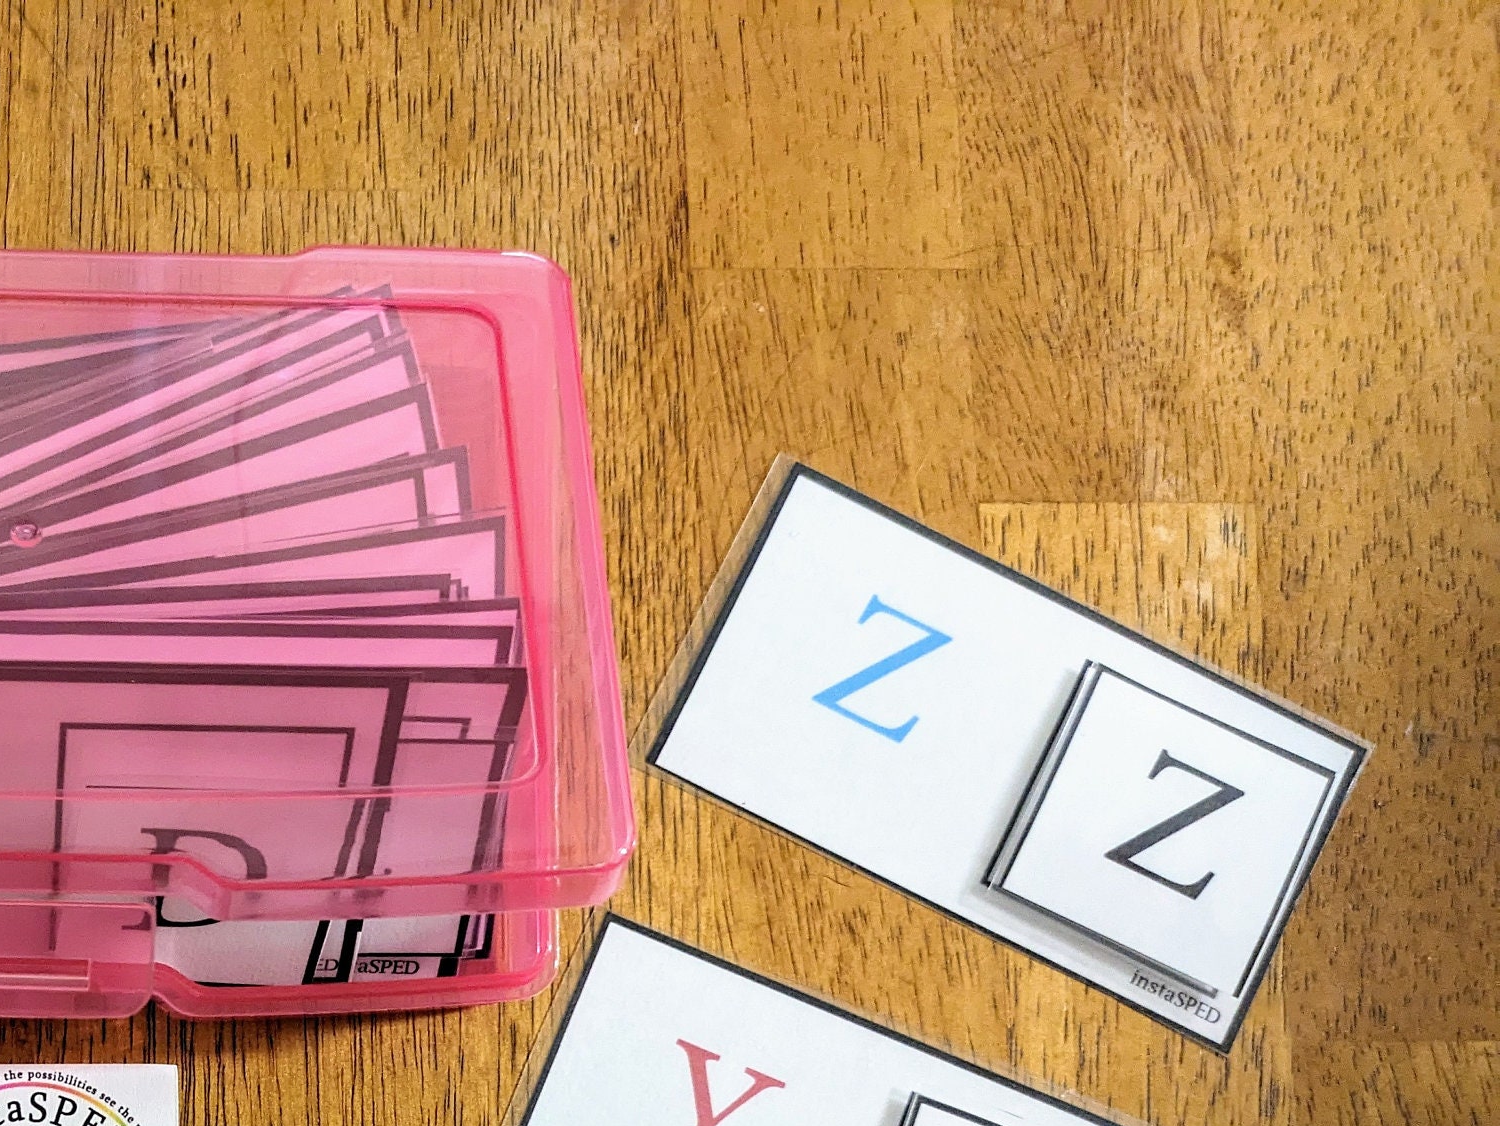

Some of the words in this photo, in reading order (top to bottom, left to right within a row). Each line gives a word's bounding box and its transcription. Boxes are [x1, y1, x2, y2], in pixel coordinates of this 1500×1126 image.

[813, 596, 952, 742] Z
[1107, 750, 1244, 899] Z
[121, 828, 268, 930] D
[1130, 968, 1222, 1024] instaSPED
[4, 1070, 22, 1080] the
[28, 1072, 97, 1094] possibilities
[100, 1094, 116, 1107] see
[118, 1106, 133, 1123] the
